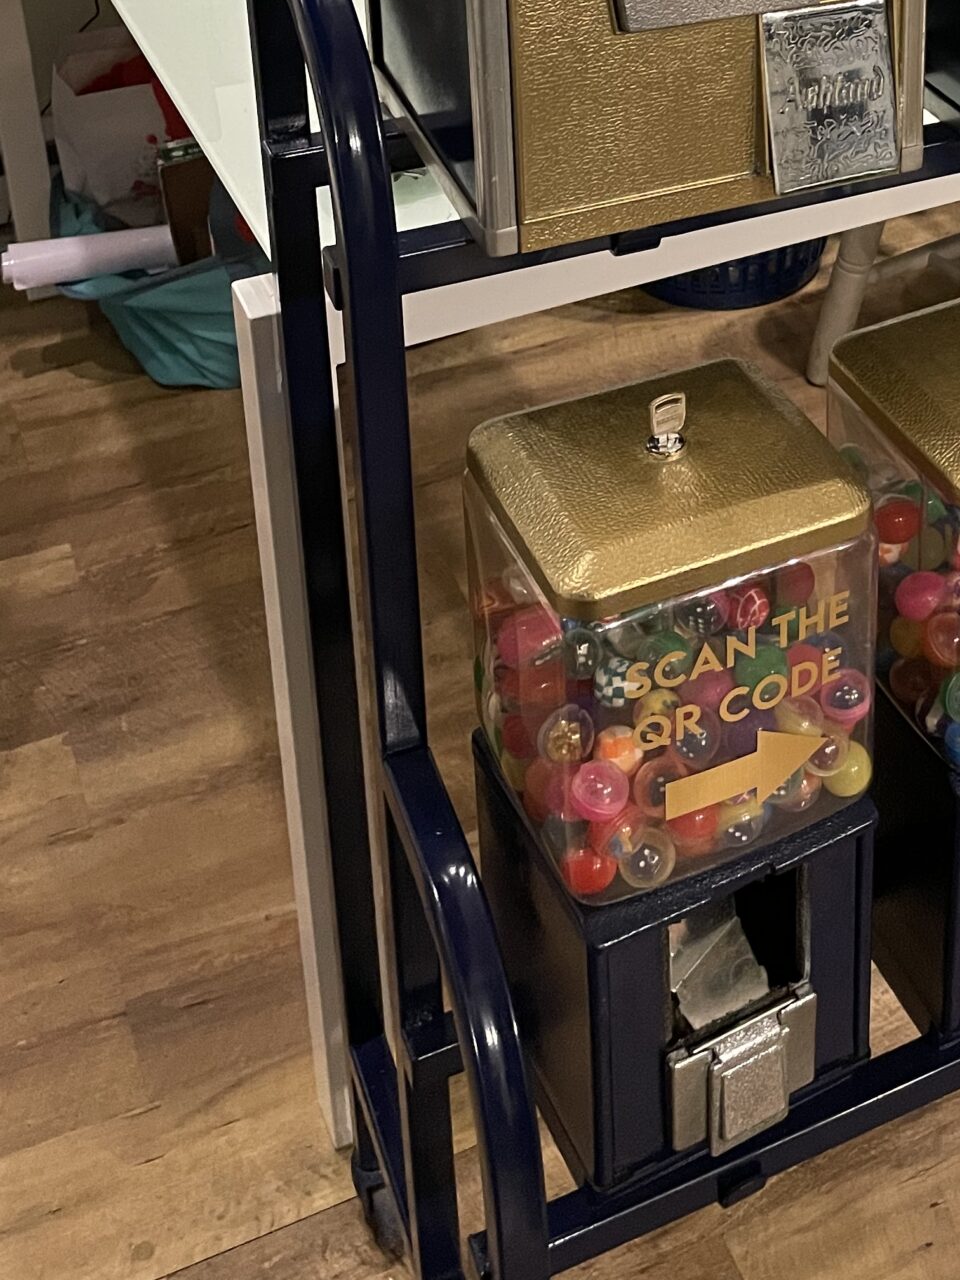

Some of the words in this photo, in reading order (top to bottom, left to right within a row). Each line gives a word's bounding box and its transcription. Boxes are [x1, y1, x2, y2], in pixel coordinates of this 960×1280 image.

[624, 626, 757, 700] SCAN
[771, 590, 850, 649] THE
[632, 703, 704, 752] QR
[719, 646, 843, 723] CODE
